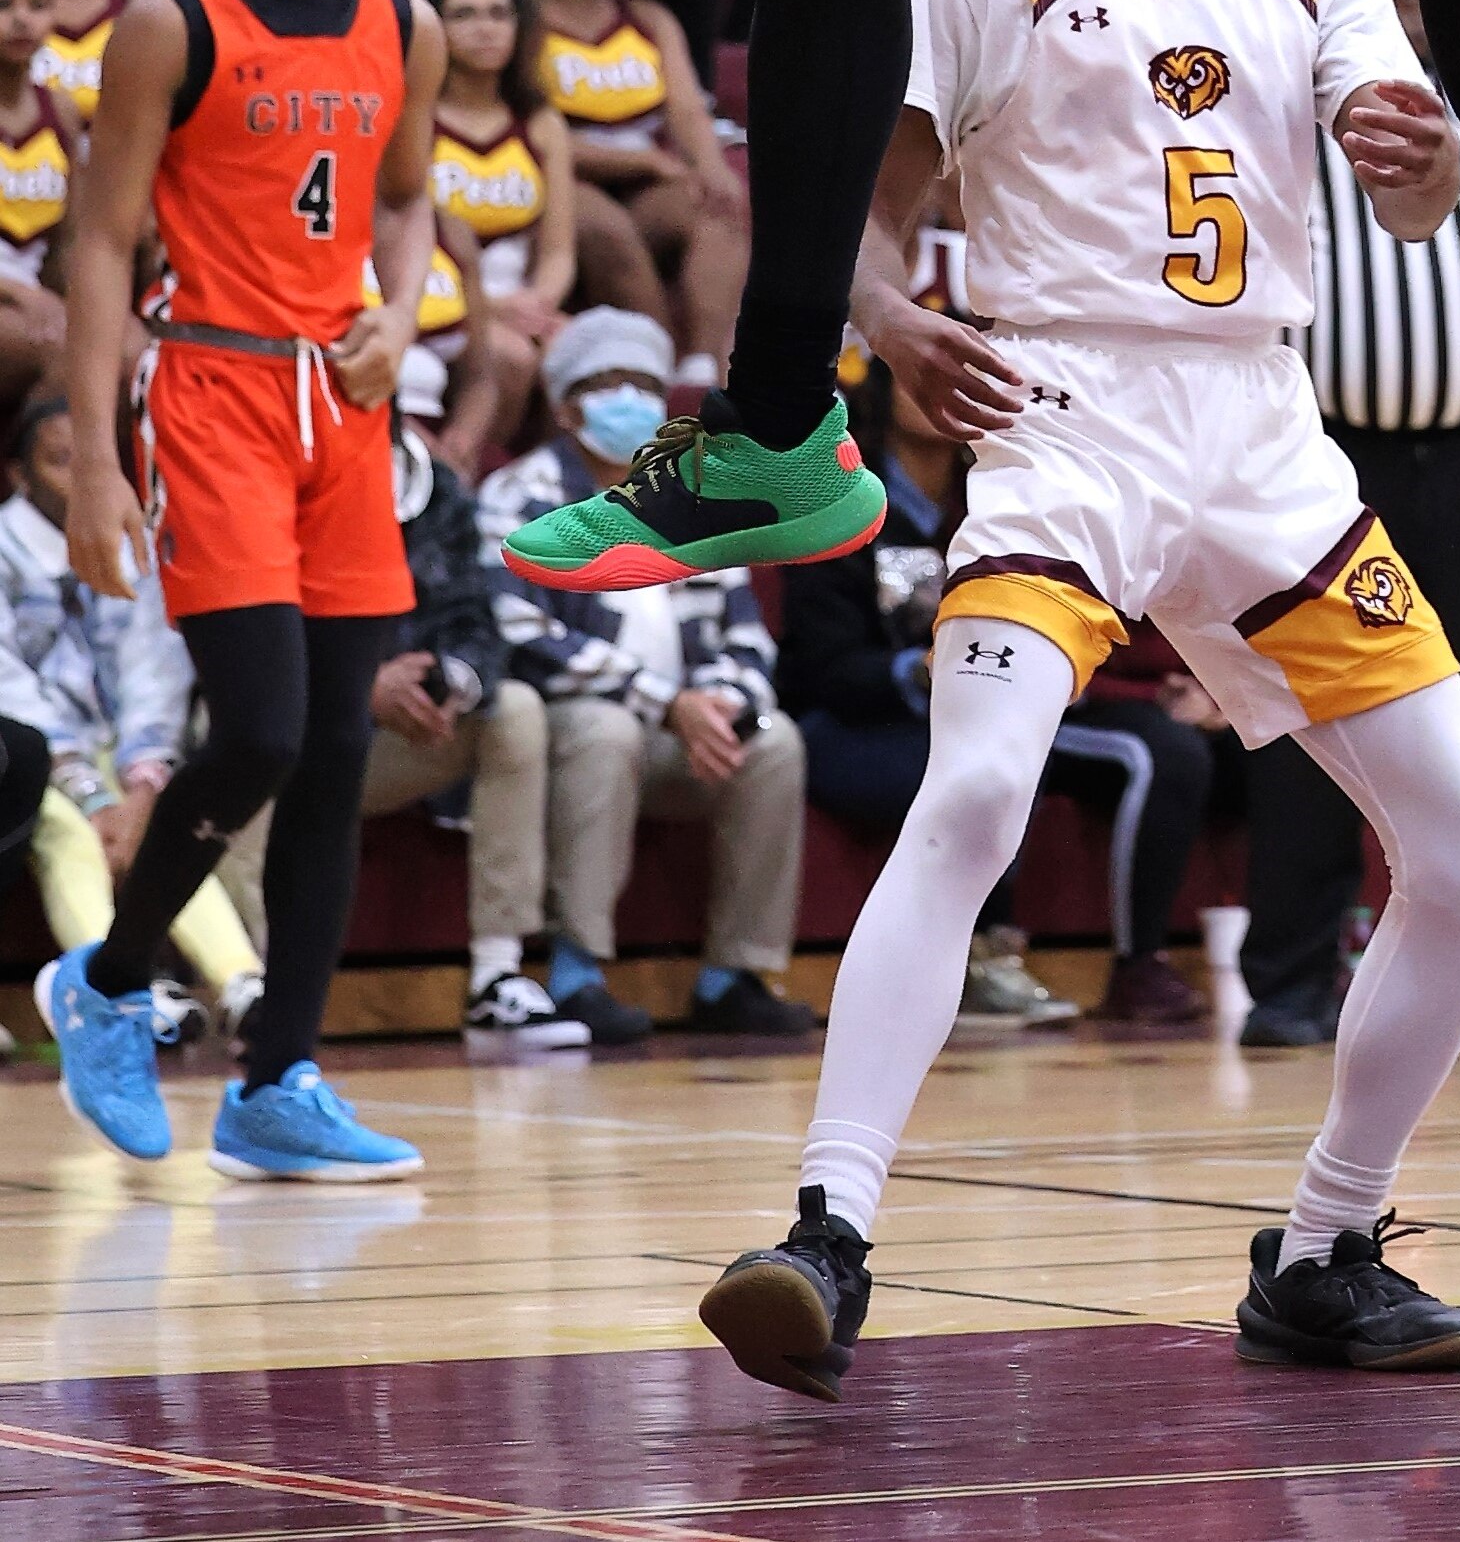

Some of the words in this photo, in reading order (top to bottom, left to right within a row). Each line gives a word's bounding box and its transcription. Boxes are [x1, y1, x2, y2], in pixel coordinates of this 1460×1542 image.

[245, 89, 383, 137] CITY
[290, 149, 339, 241] 4
[1162, 145, 1248, 308] 5
